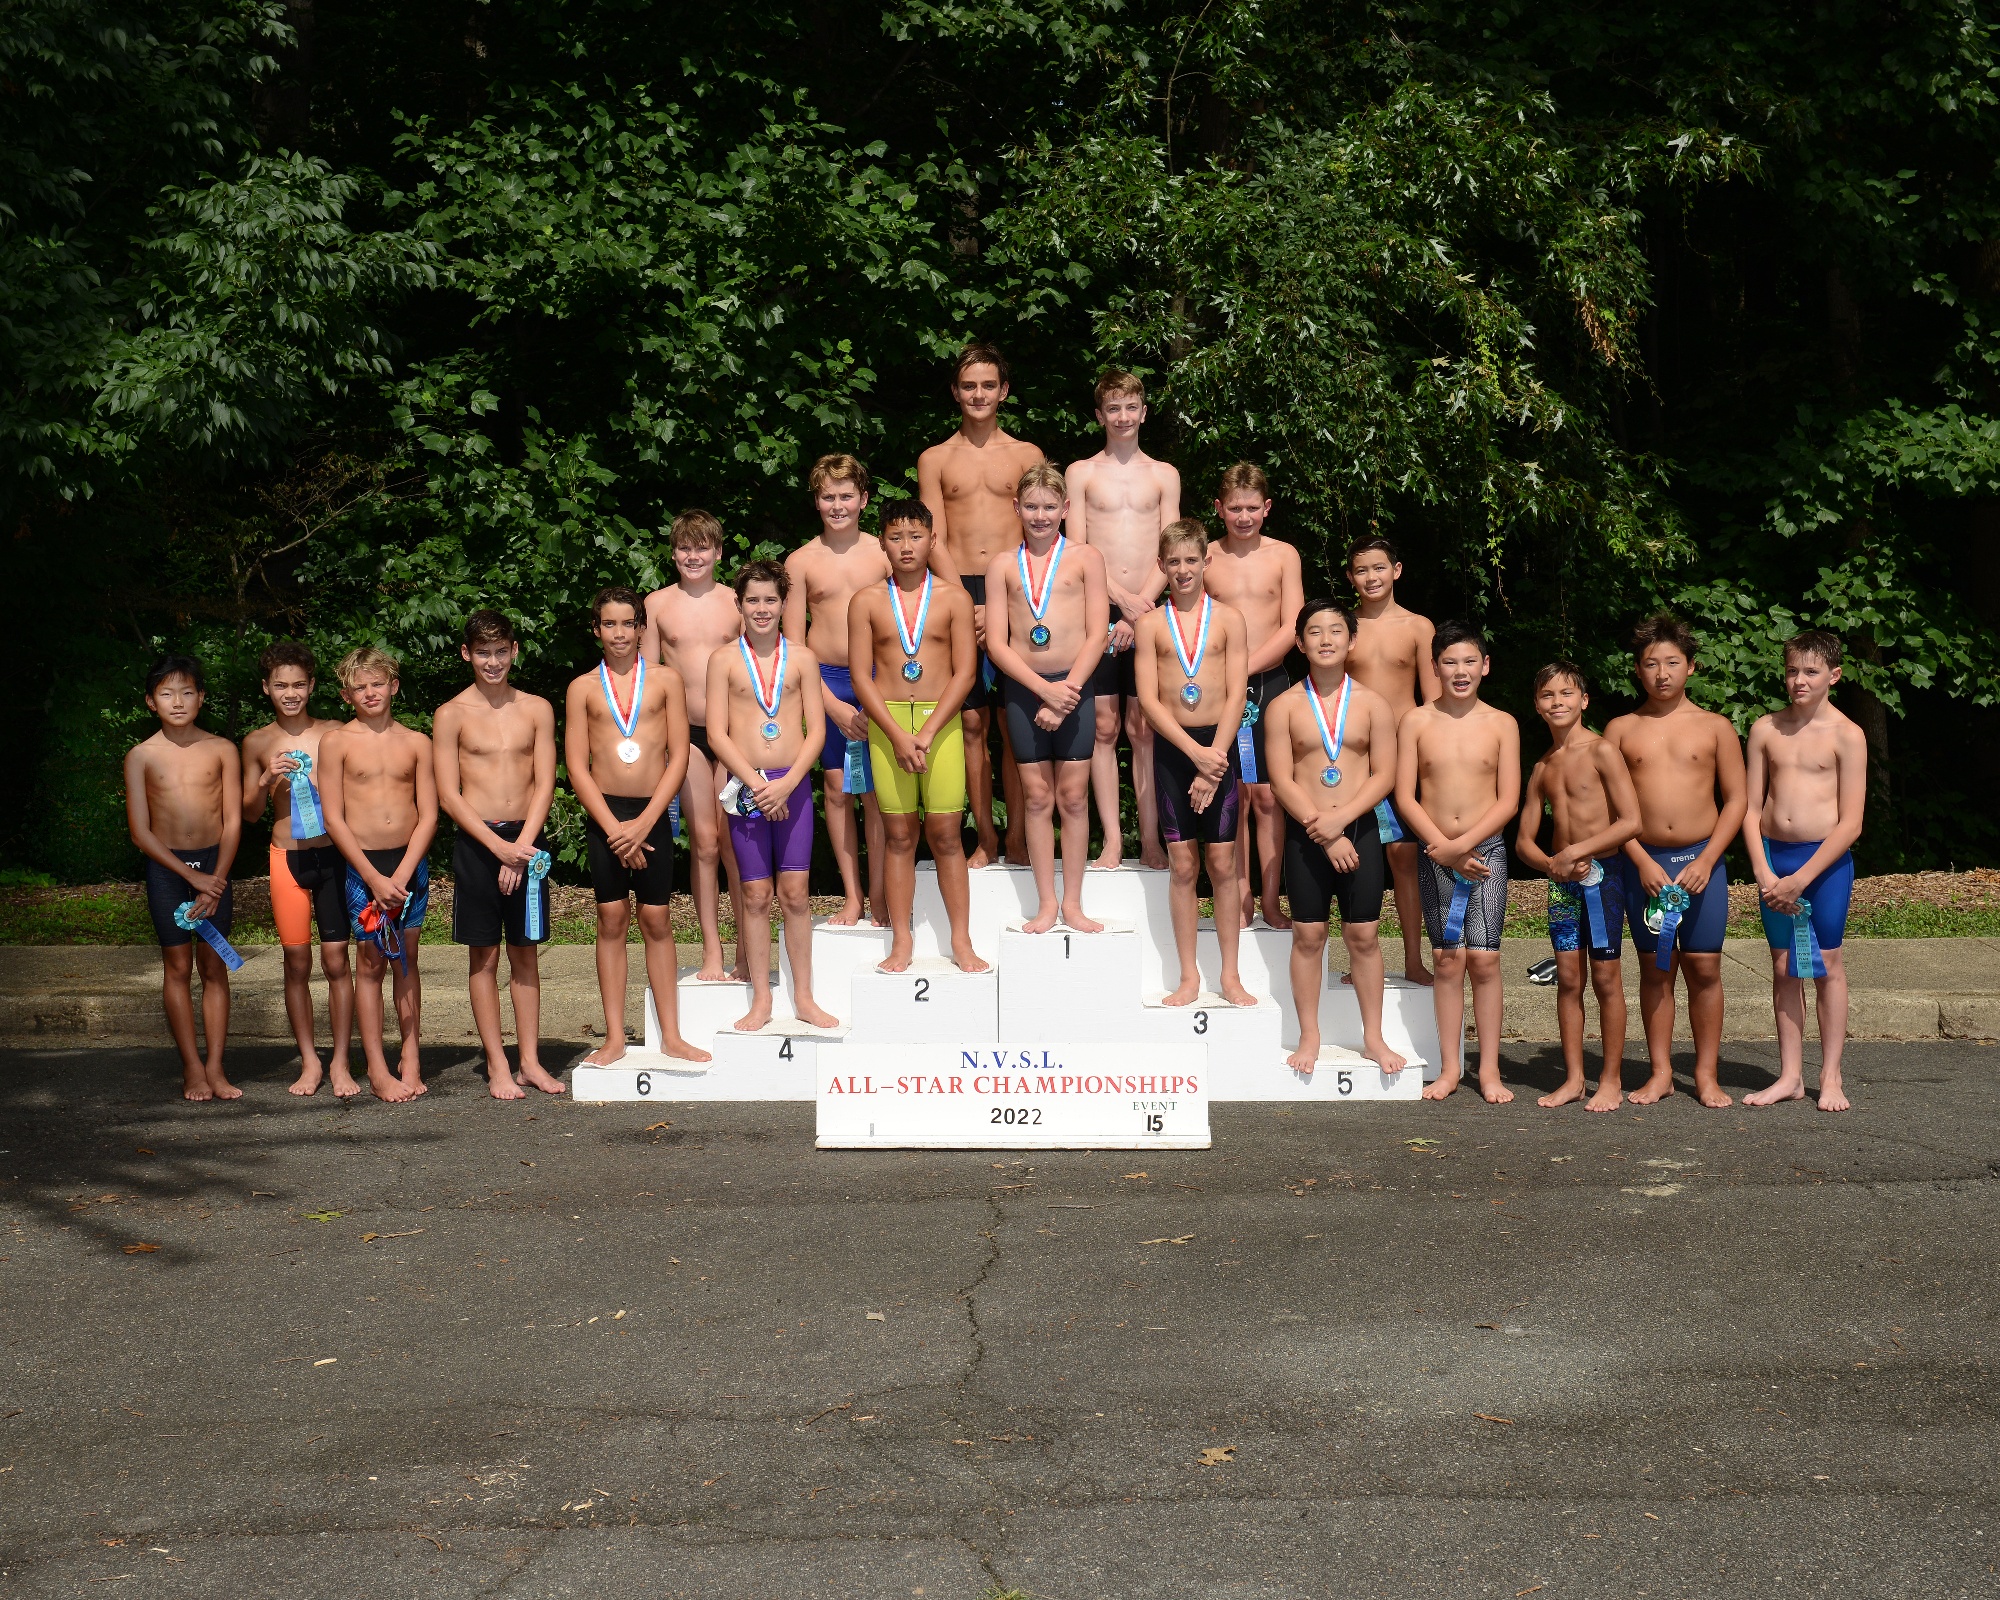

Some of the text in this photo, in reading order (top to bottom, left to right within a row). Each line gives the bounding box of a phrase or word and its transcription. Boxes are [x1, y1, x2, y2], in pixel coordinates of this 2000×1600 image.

[1671, 854, 1695, 862] arena
[1062, 934, 1070, 959] 1
[914, 977, 930, 1002] 2
[1193, 1010, 1208, 1035] 3
[777, 1037, 794, 1062] 4
[961, 1050, 1063, 1069] N.V.S.L.
[636, 1072, 651, 1096] 6
[827, 1076, 1198, 1095] ALL-STAR CHAMPIONSHIPS
[1337, 1072, 1353, 1096] 5
[990, 1107, 1042, 1125] 2022
[1133, 1101, 1177, 1111] EVENT
[1147, 1114, 1164, 1132] 15
